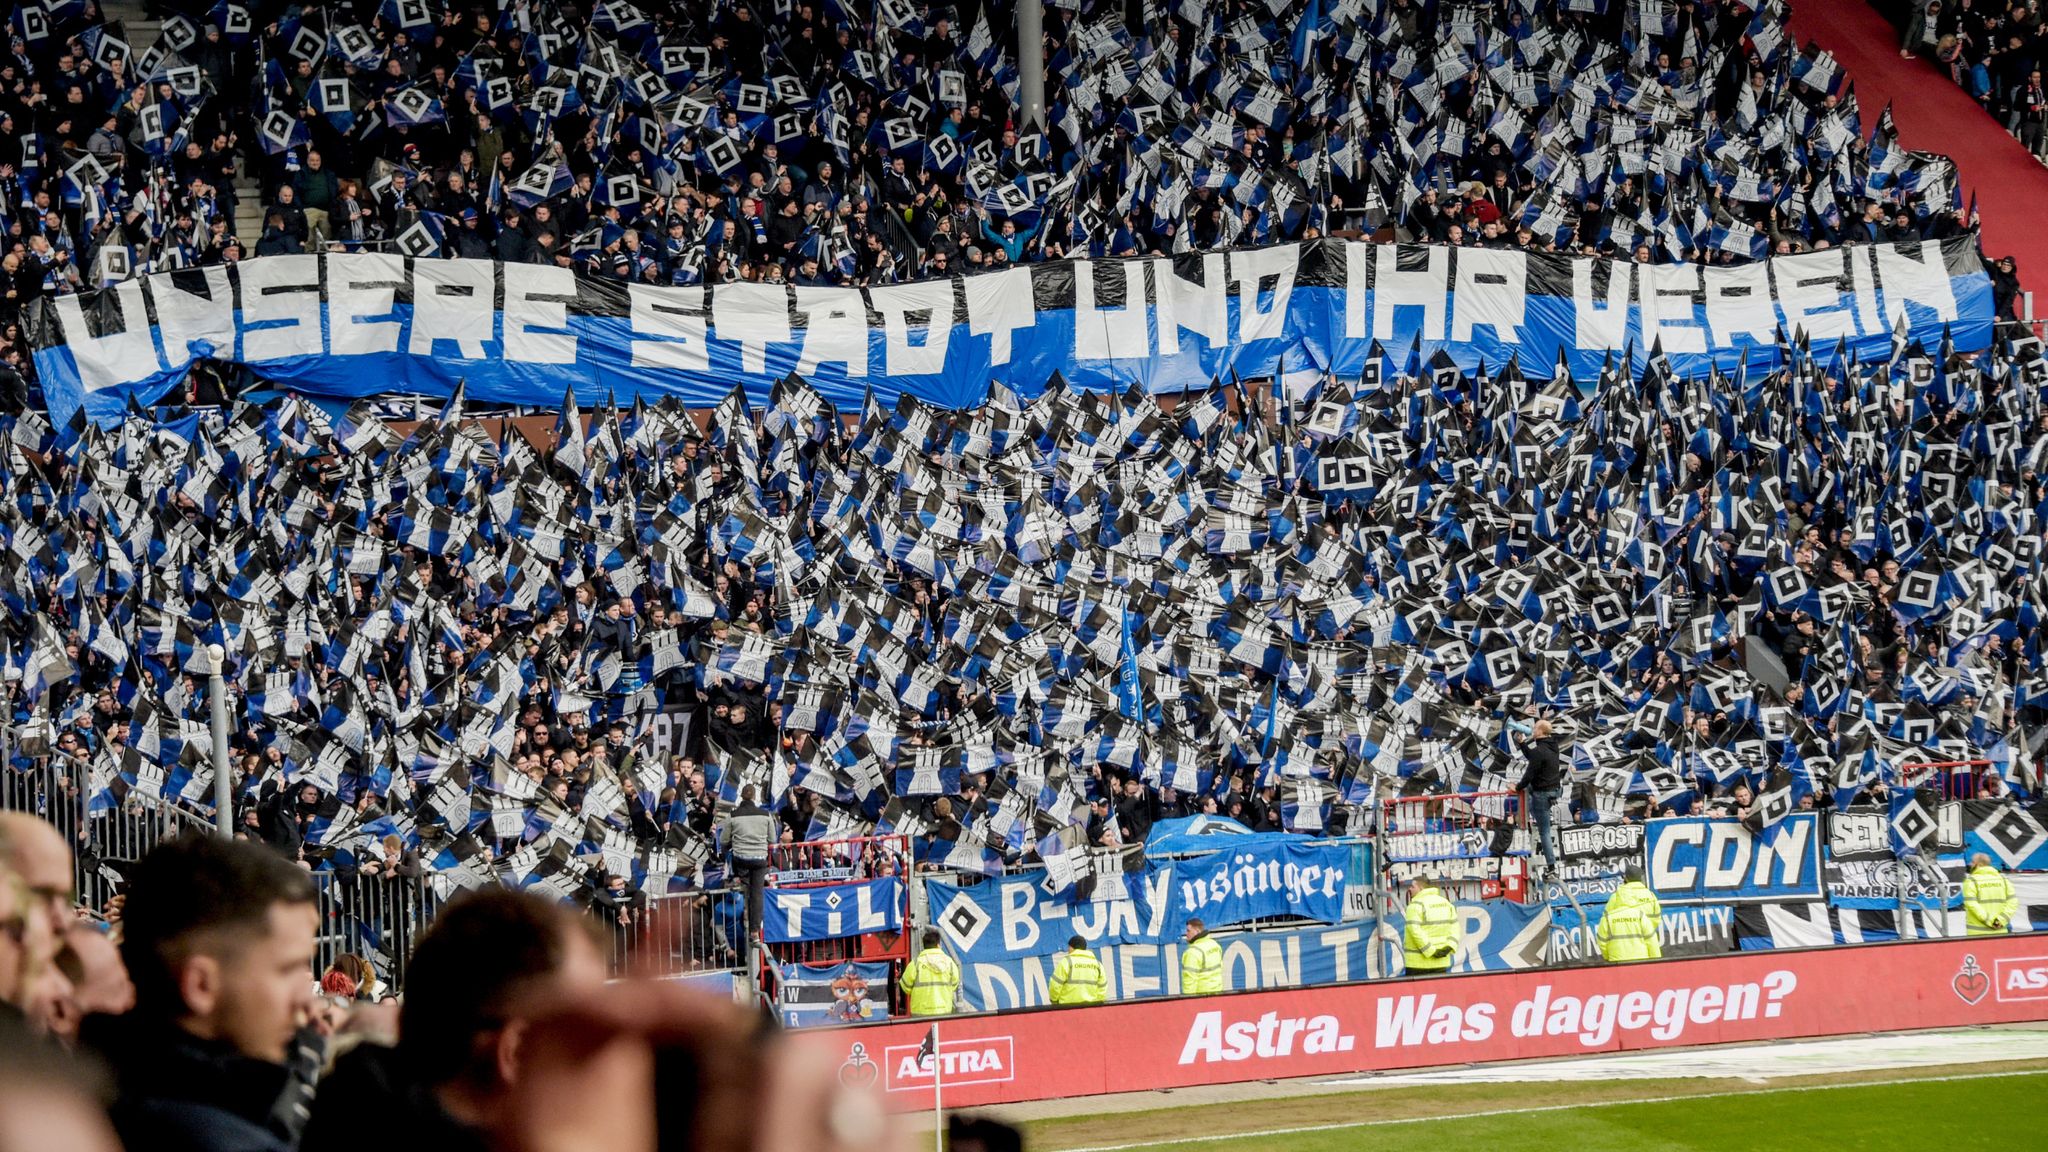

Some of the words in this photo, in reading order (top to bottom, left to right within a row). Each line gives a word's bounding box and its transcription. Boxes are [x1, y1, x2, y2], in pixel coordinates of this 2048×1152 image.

[54, 253, 578, 393] UNSERE
[628, 266, 1035, 377] STADT
[1075, 242, 1300, 359] UND
[1346, 242, 1527, 343] IHR
[1573, 239, 1958, 353] VEREIN
[1561, 829, 1592, 855] HH
[1603, 825, 1643, 849] OST
[1652, 820, 1811, 892] CDN
[1222, 935, 1302, 991] ON
[1320, 906, 1492, 981] TOR
[1551, 925, 1602, 963] IRON
[1177, 1010, 1355, 1065] Astra.
[1375, 993, 1496, 1048] Was
[1511, 970, 1798, 1047] dagegen?
[896, 1048, 1003, 1079] ASTRA
